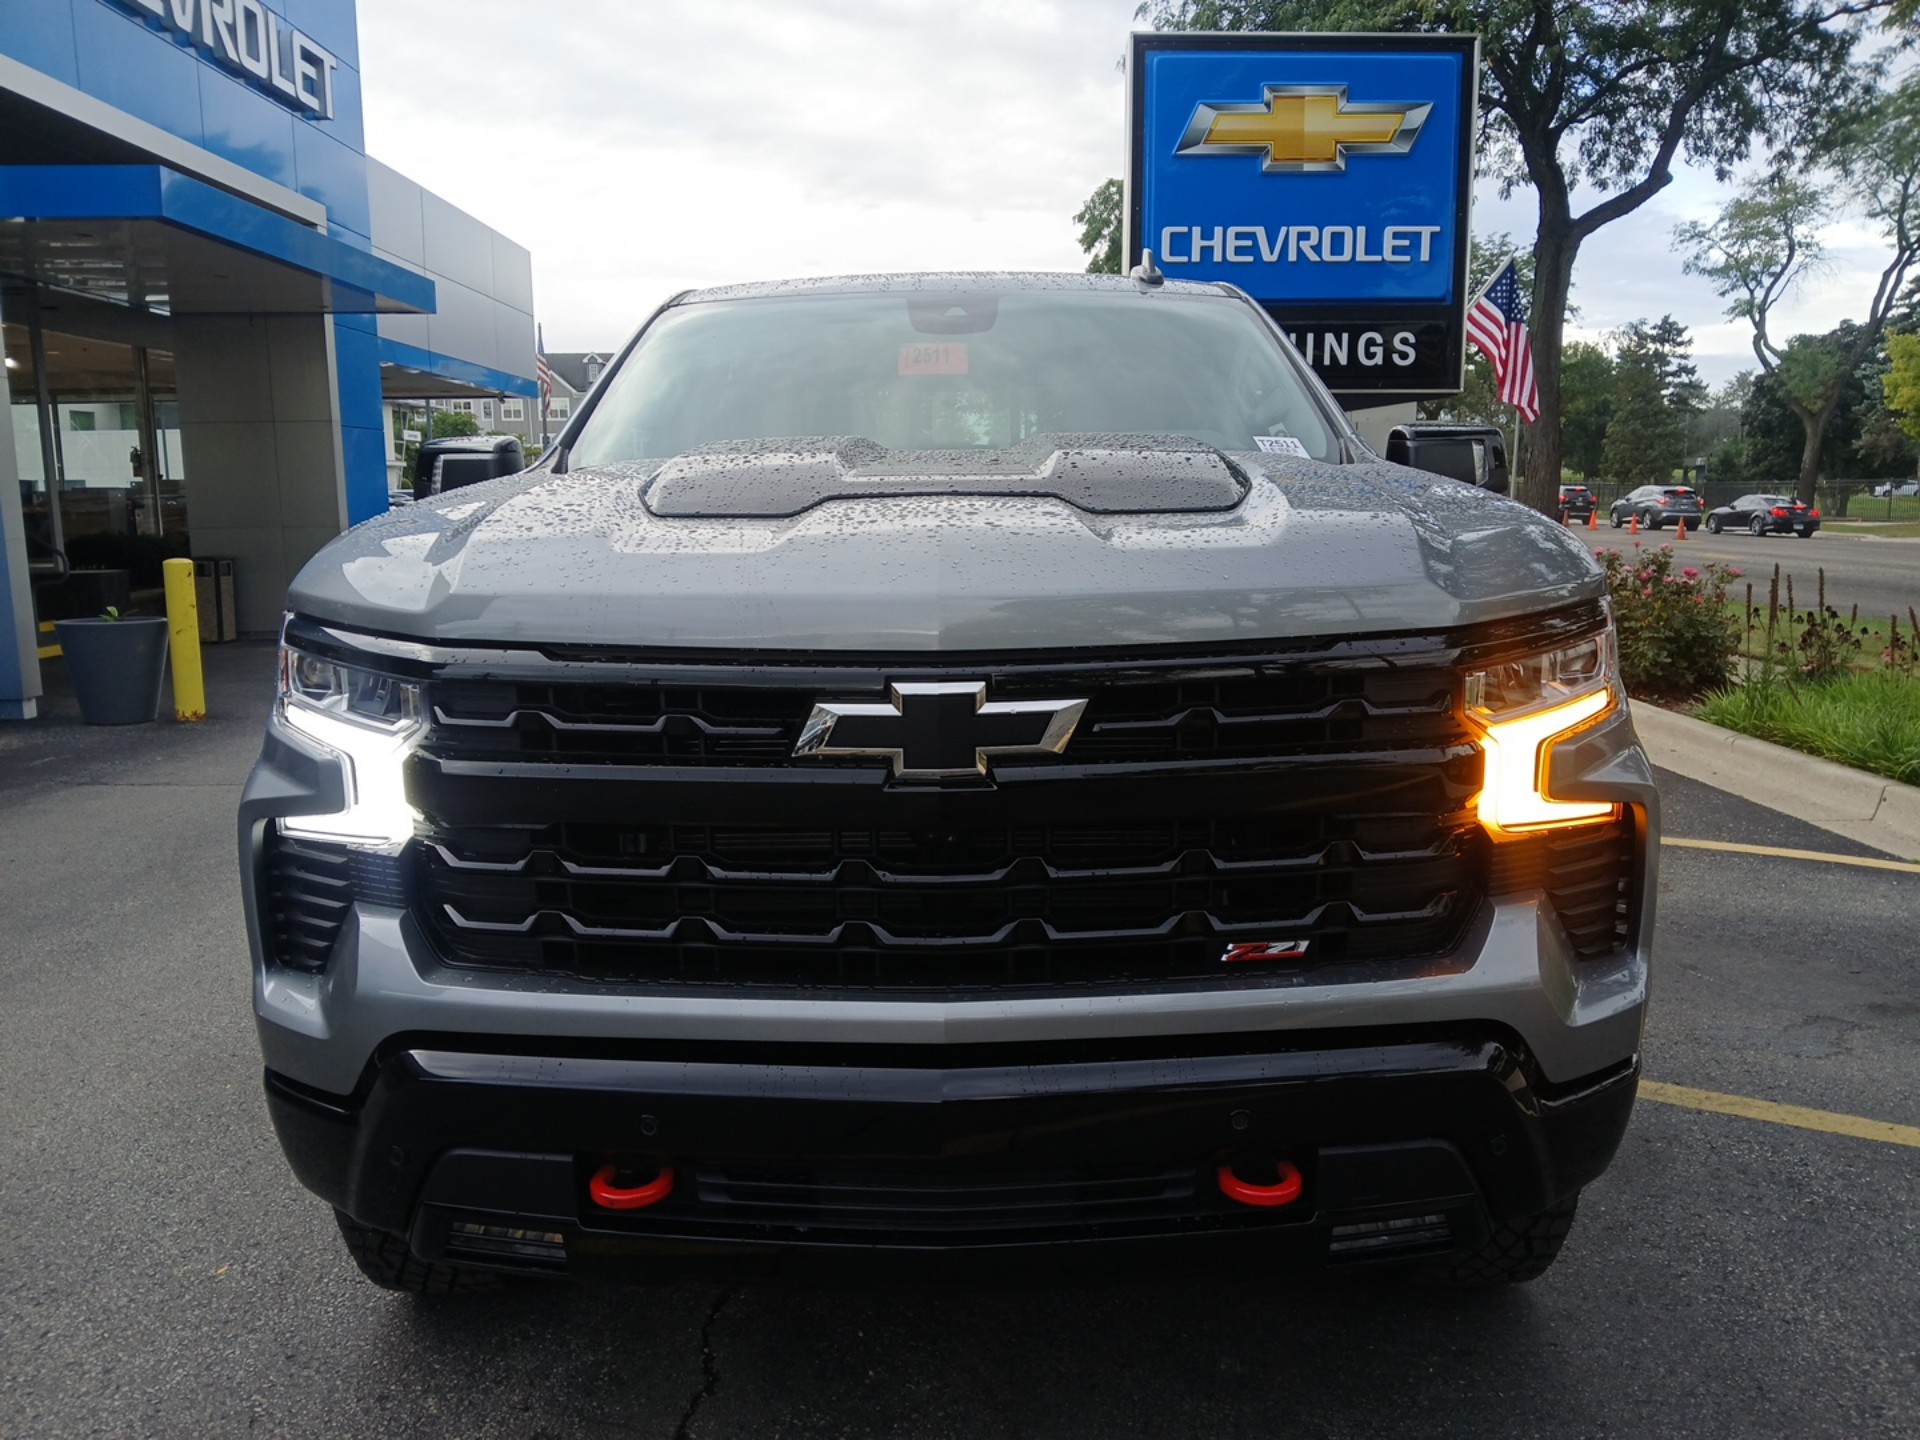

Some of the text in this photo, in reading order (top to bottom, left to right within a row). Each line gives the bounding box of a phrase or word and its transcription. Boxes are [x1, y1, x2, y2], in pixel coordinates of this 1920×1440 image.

[137, 0, 338, 120] ROLET
[1161, 225, 1440, 262] CHEVROLET
[911, 346, 950, 364] 2511
[1290, 331, 1416, 366] INGS
[1258, 439, 1300, 449] T2511
[1221, 940, 1310, 961] Z71
